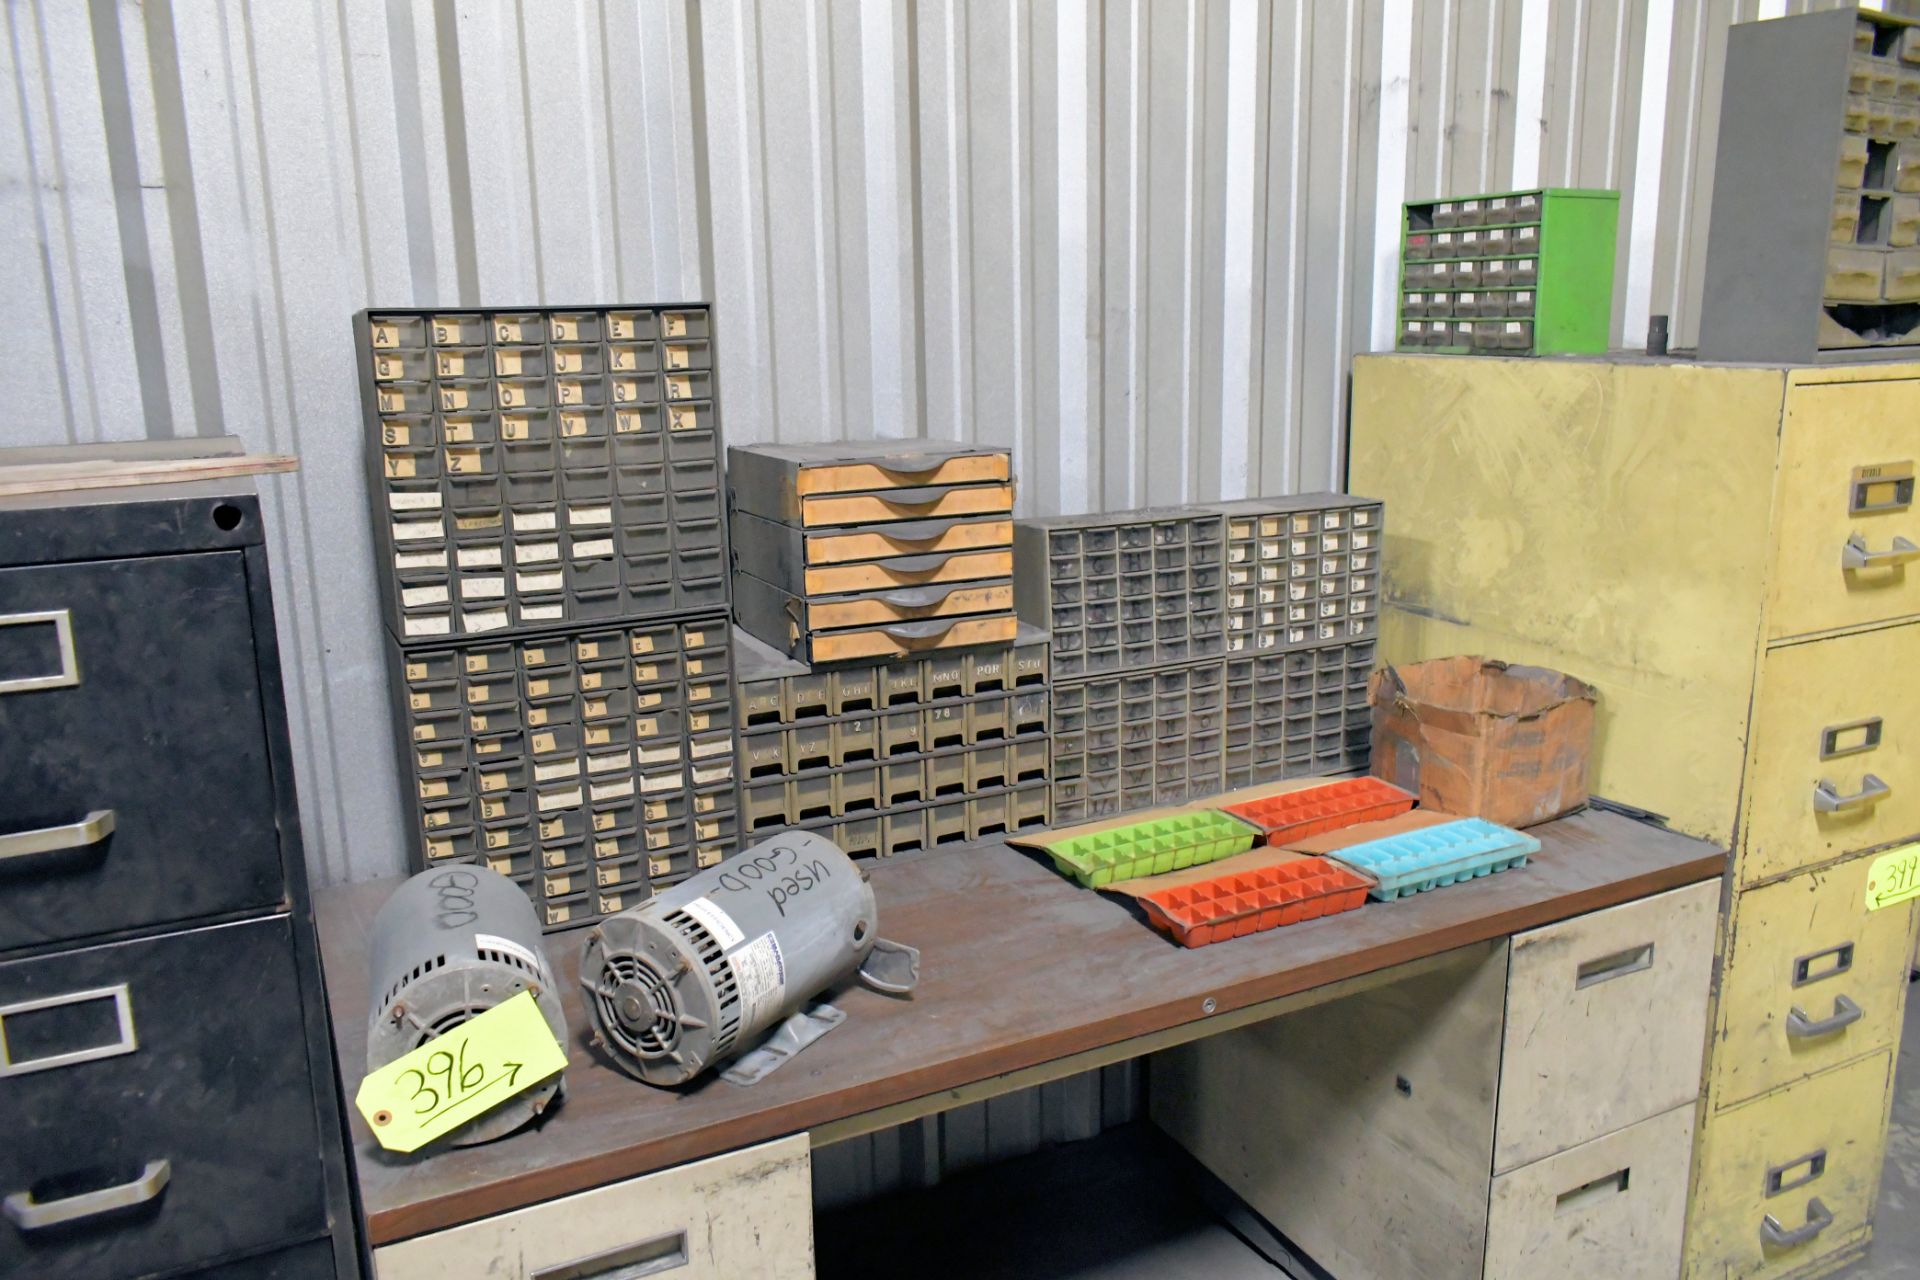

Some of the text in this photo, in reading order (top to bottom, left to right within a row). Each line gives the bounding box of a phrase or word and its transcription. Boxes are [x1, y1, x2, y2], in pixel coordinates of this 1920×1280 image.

[376, 327, 388, 343] A
[437, 327, 448, 342] B
[499, 325, 509, 341] C
[556, 324, 565, 339] D
[613, 321, 622, 337] E
[668, 320, 675, 336] F
[379, 358, 390, 376] G
[442, 358, 451, 374] H
[557, 355, 567, 371] J
[614, 352, 623, 368] K
[671, 353, 680, 368] L
[503, 389, 513, 404] O
[561, 388, 571, 402] P
[616, 384, 625, 401] Q
[671, 384, 680, 398] R
[381, 395, 393, 410] M
[444, 394, 455, 408] N
[563, 420, 574, 435] V
[619, 415, 632, 431] W
[673, 413, 684, 429] X
[385, 428, 396, 443] S
[446, 426, 458, 442] T
[505, 424, 515, 437] U
[388, 460, 399, 476] Y
[450, 457, 462, 471] Z
[854, 721, 861, 732] 2
[395, 1037, 484, 1114] 396
